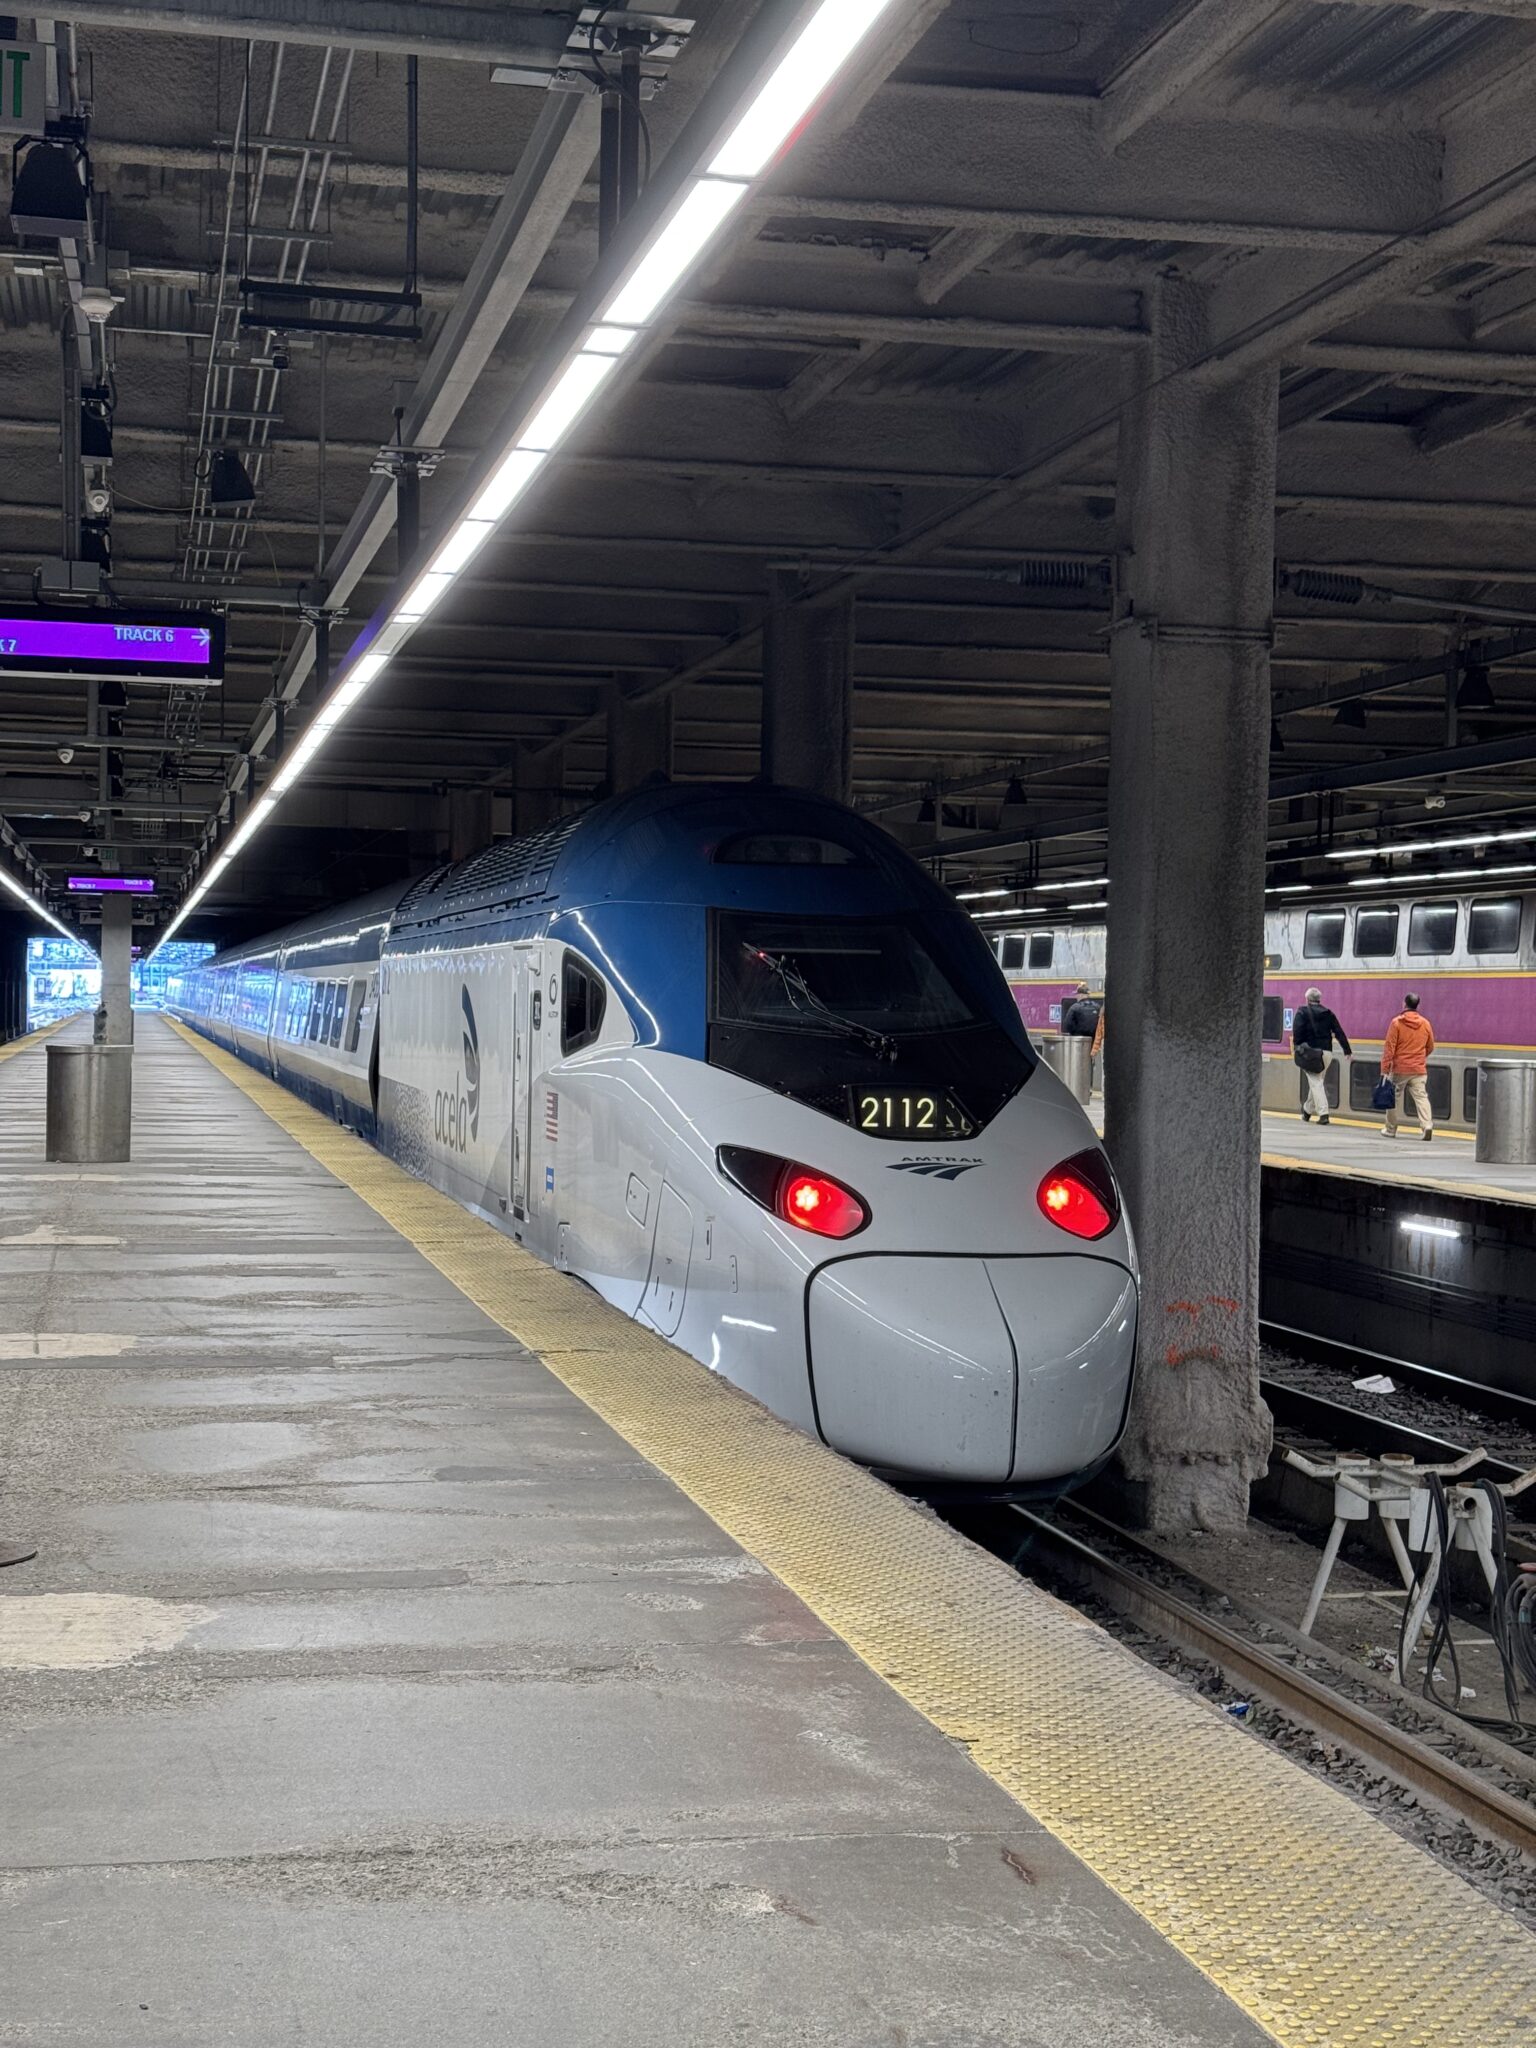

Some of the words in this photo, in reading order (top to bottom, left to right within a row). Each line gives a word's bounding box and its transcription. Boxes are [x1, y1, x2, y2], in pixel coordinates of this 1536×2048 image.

[8, 639, 17, 651] 7
[114, 627, 161, 641] TRACK
[165, 629, 174, 642] 6
[434, 1070, 466, 1153] acela
[861, 1097, 934, 1128] 2112
